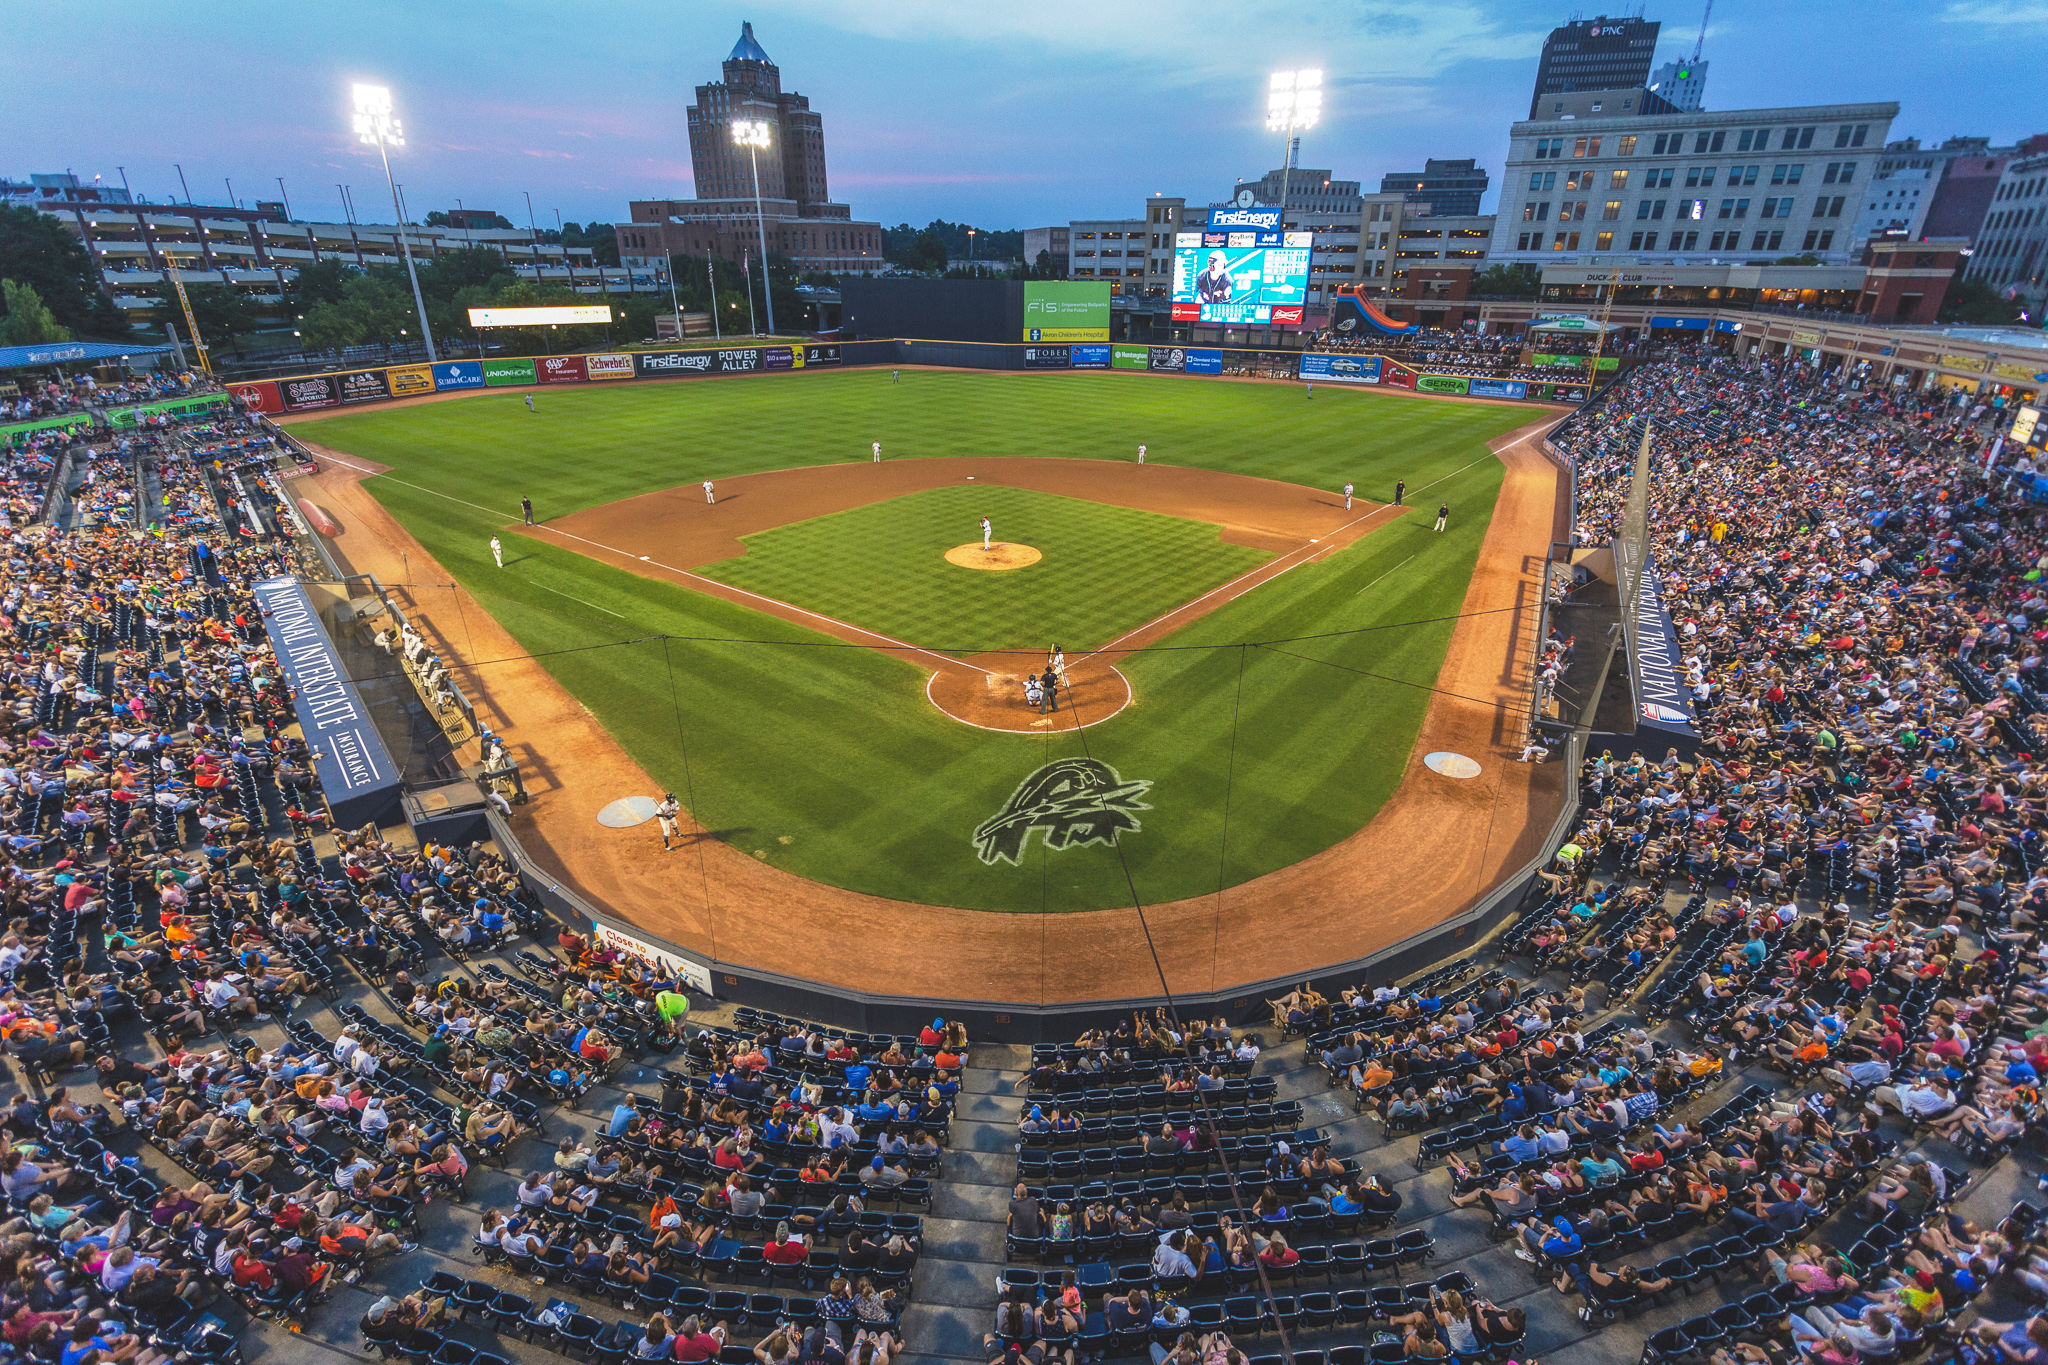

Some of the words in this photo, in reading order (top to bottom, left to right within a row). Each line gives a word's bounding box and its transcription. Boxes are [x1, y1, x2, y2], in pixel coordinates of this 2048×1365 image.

[1602, 26, 1624, 35] PNC
[1213, 210, 1279, 226] FirstEnergy
[643, 354, 711, 367] FirstEnergy
[719, 350, 757, 360] POWER
[1172, 350, 1182, 362] 25
[589, 357, 630, 370] Schwebel's
[722, 360, 756, 371] ALLEY
[1425, 379, 1465, 389] SERRA
[296, 394, 327, 402] EMPORIUM
[266, 588, 318, 646] NATIONAL
[1637, 630, 1681, 706] NATIONAL
[287, 641, 358, 730] INTERSTATE
[335, 731, 372, 787] INSURANCE
[606, 930, 633, 948] Close
[635, 943, 647, 953] to
